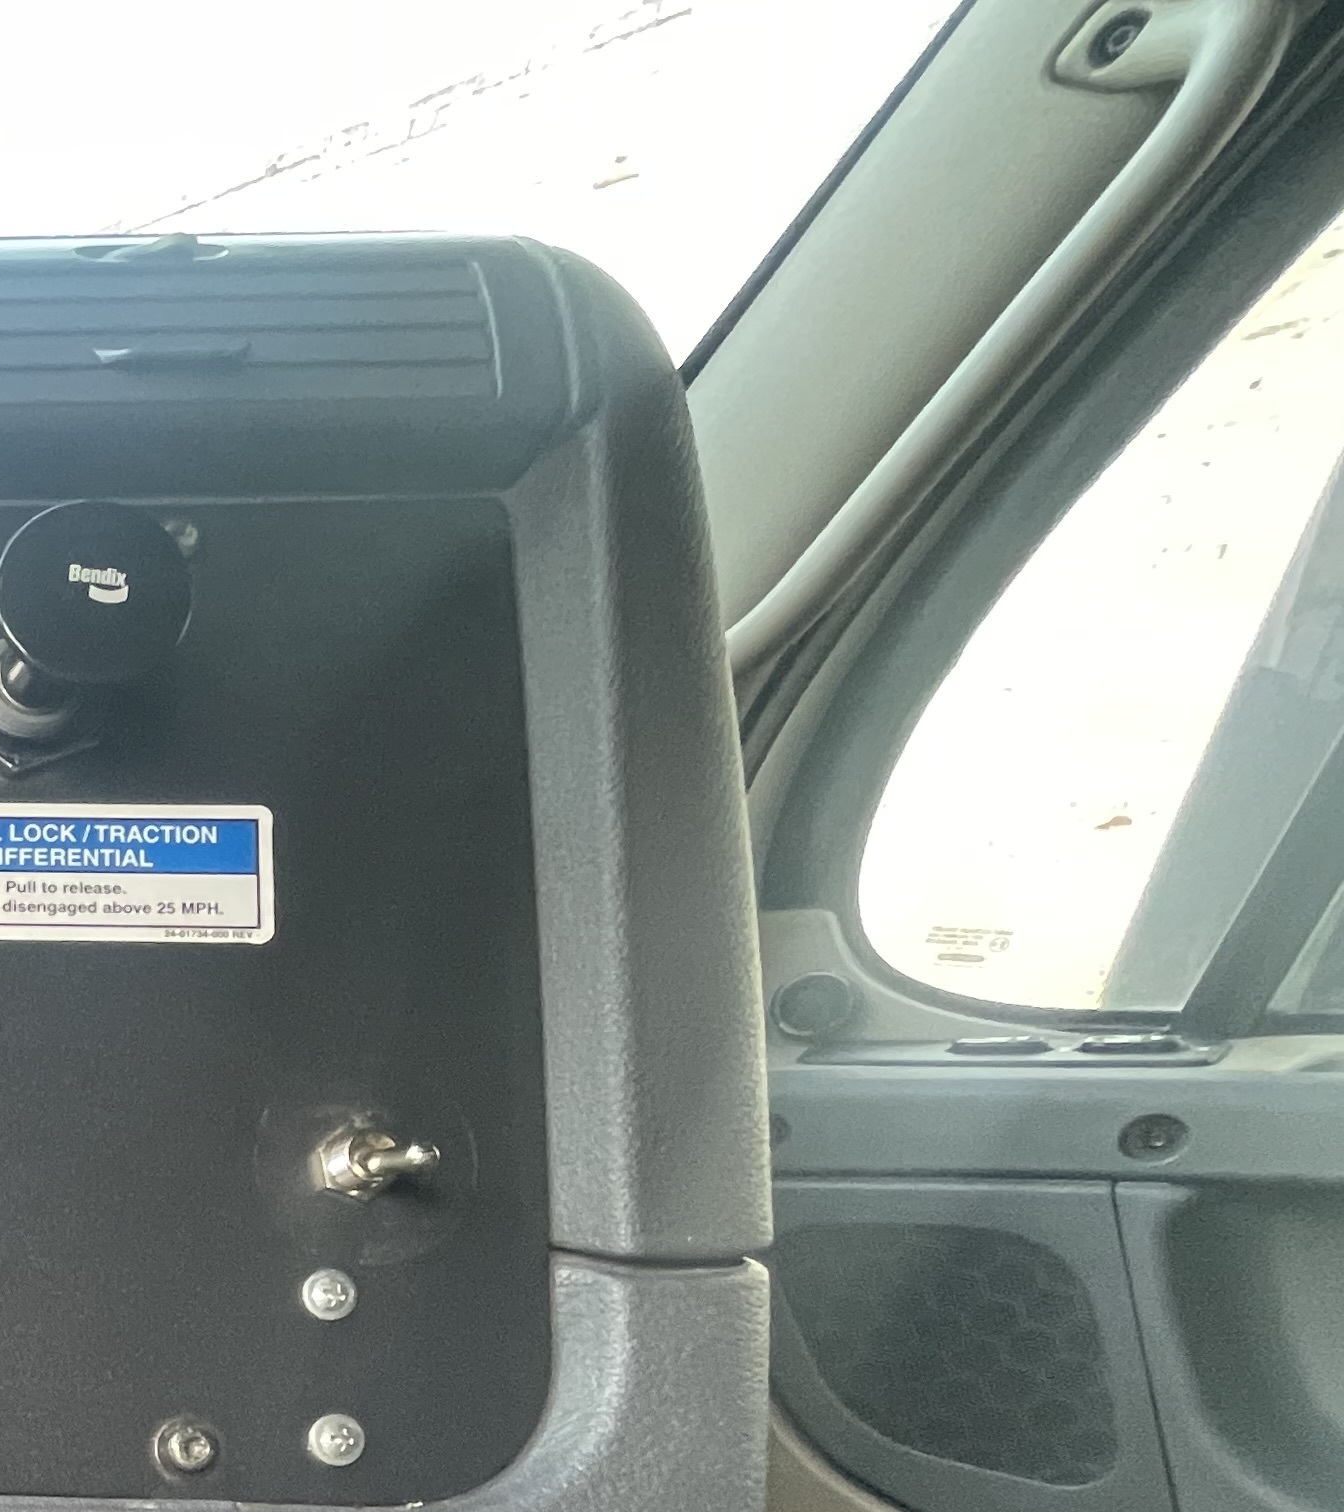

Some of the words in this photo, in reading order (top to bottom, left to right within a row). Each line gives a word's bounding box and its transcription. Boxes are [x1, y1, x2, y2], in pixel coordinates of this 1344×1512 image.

[68, 564, 127, 587] Bendix
[9, 823, 75, 843] LOCK
[5, 881, 38, 894] Pull
[42, 882, 58, 894] to
[62, 882, 128, 895] release.
[2, 900, 98, 916] disengaged
[102, 901, 152, 915] above
[157, 902, 176, 915] 25
[181, 902, 225, 916] MPH.
